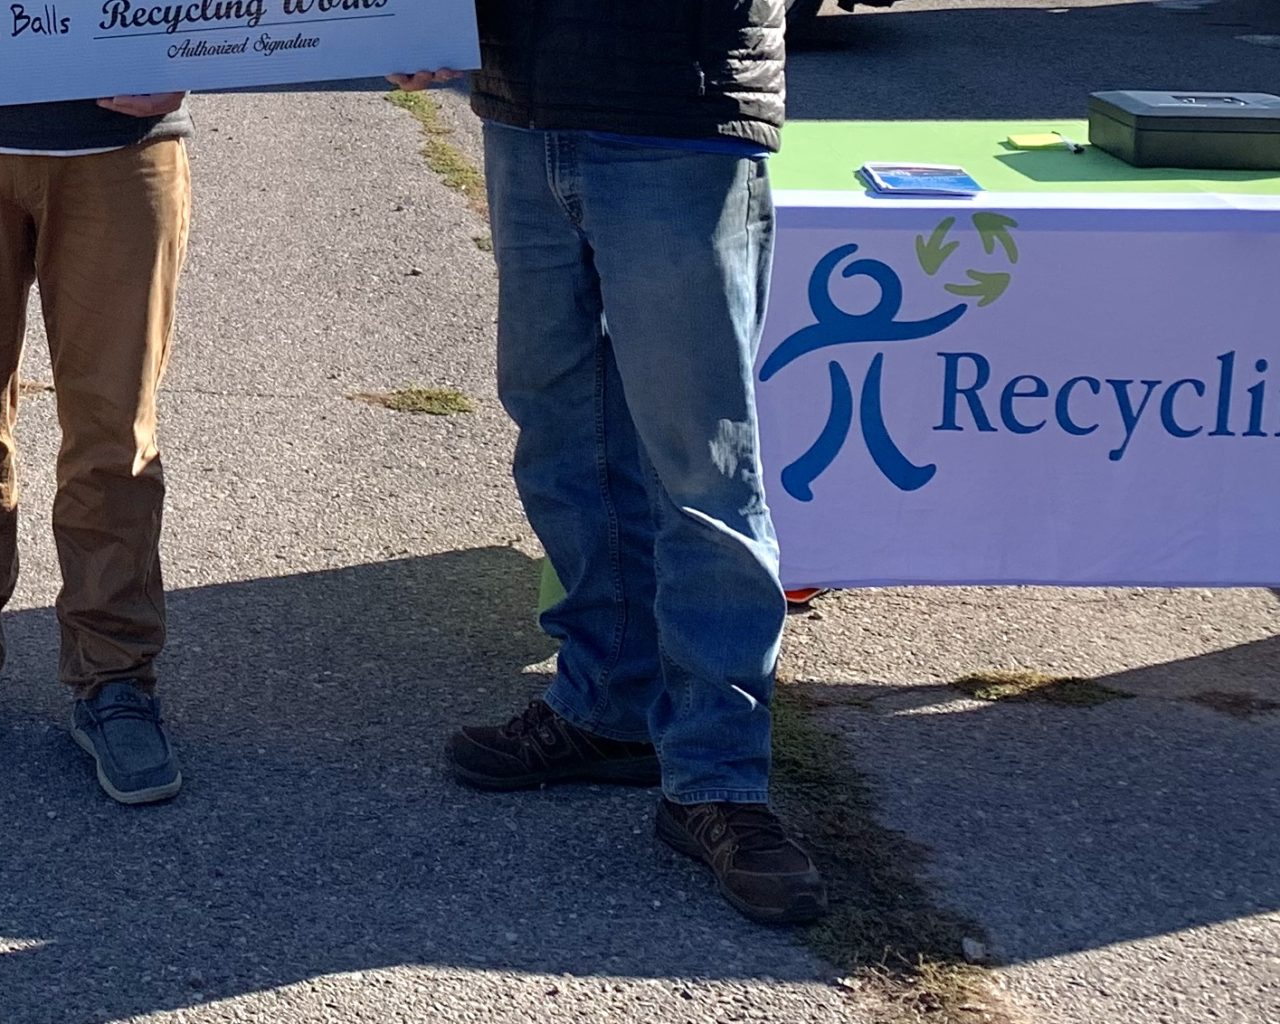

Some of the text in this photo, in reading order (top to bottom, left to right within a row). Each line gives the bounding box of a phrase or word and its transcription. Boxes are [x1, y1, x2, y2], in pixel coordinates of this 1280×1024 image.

[10, 3, 71, 38] Balls
[167, 33, 320, 58] Authorized Signature
[933, 350, 1280, 462] Recycli
